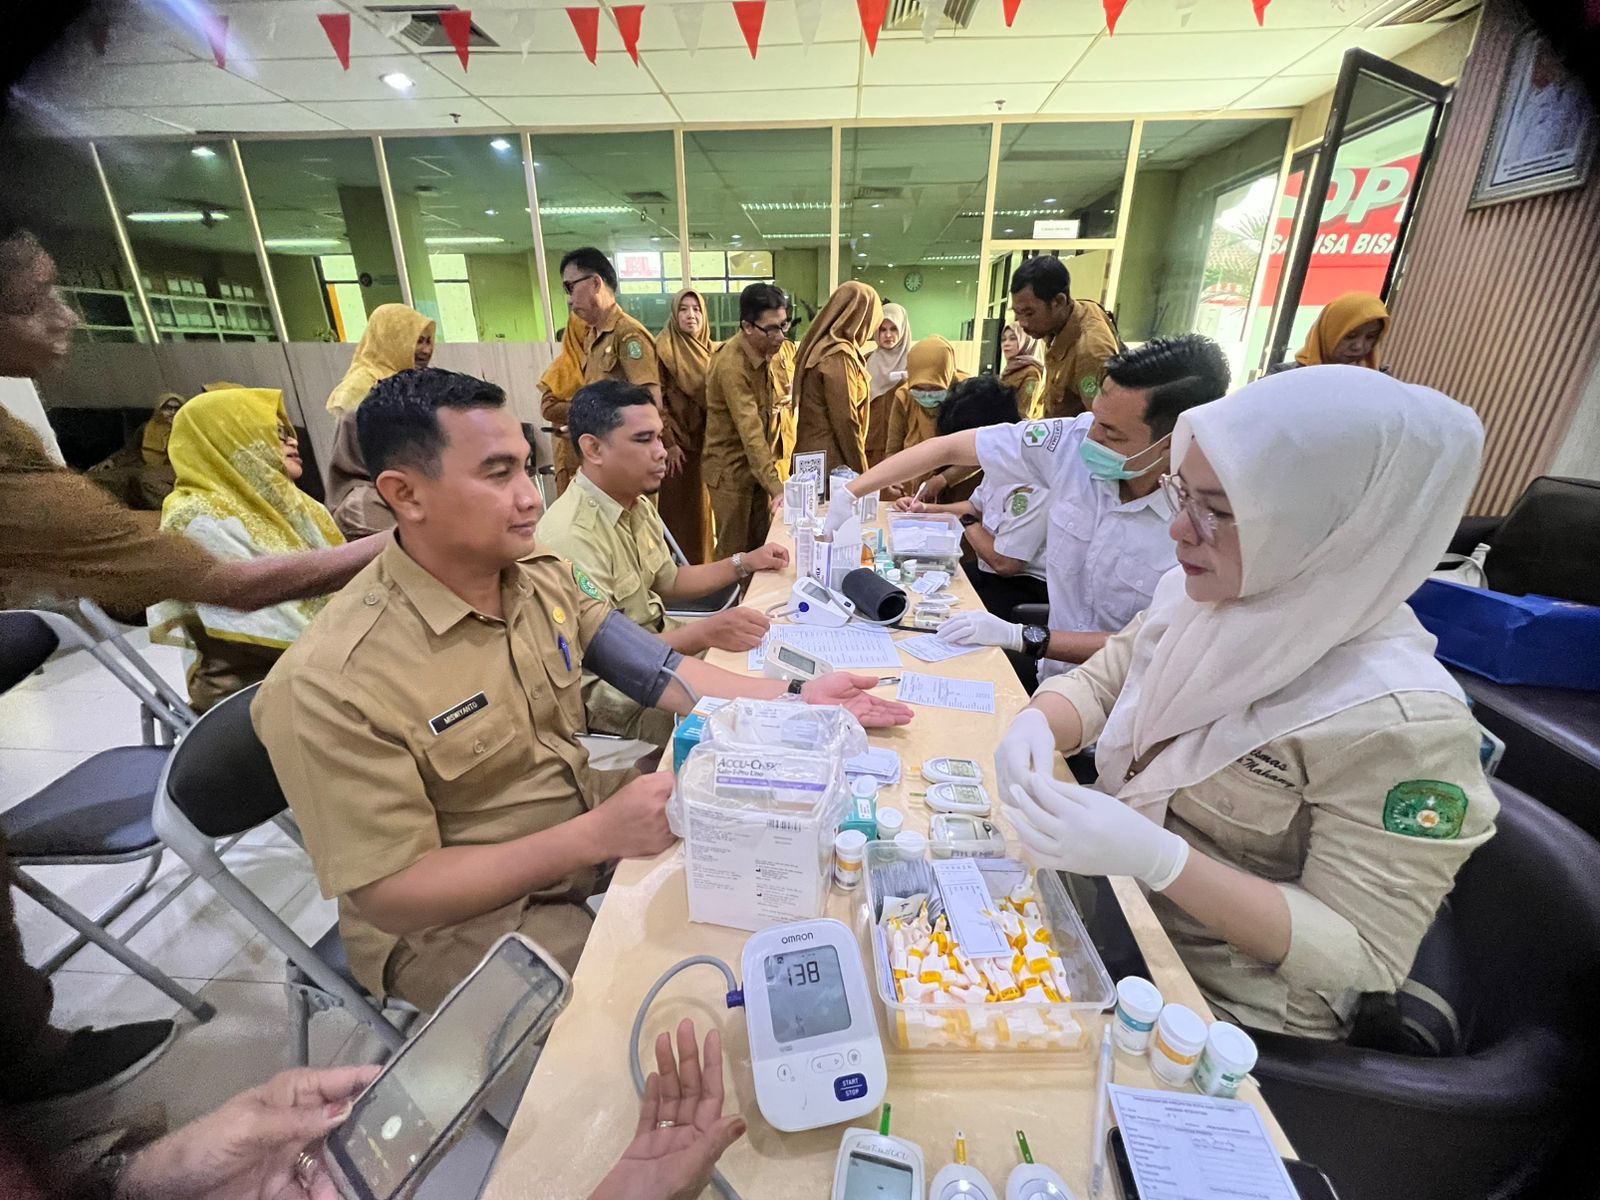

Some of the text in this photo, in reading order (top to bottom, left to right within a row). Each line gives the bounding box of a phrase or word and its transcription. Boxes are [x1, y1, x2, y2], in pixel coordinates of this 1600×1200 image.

[787, 960, 820, 987] 138
[842, 1077, 859, 1087] START
[845, 1088, 859, 1097] STOP
